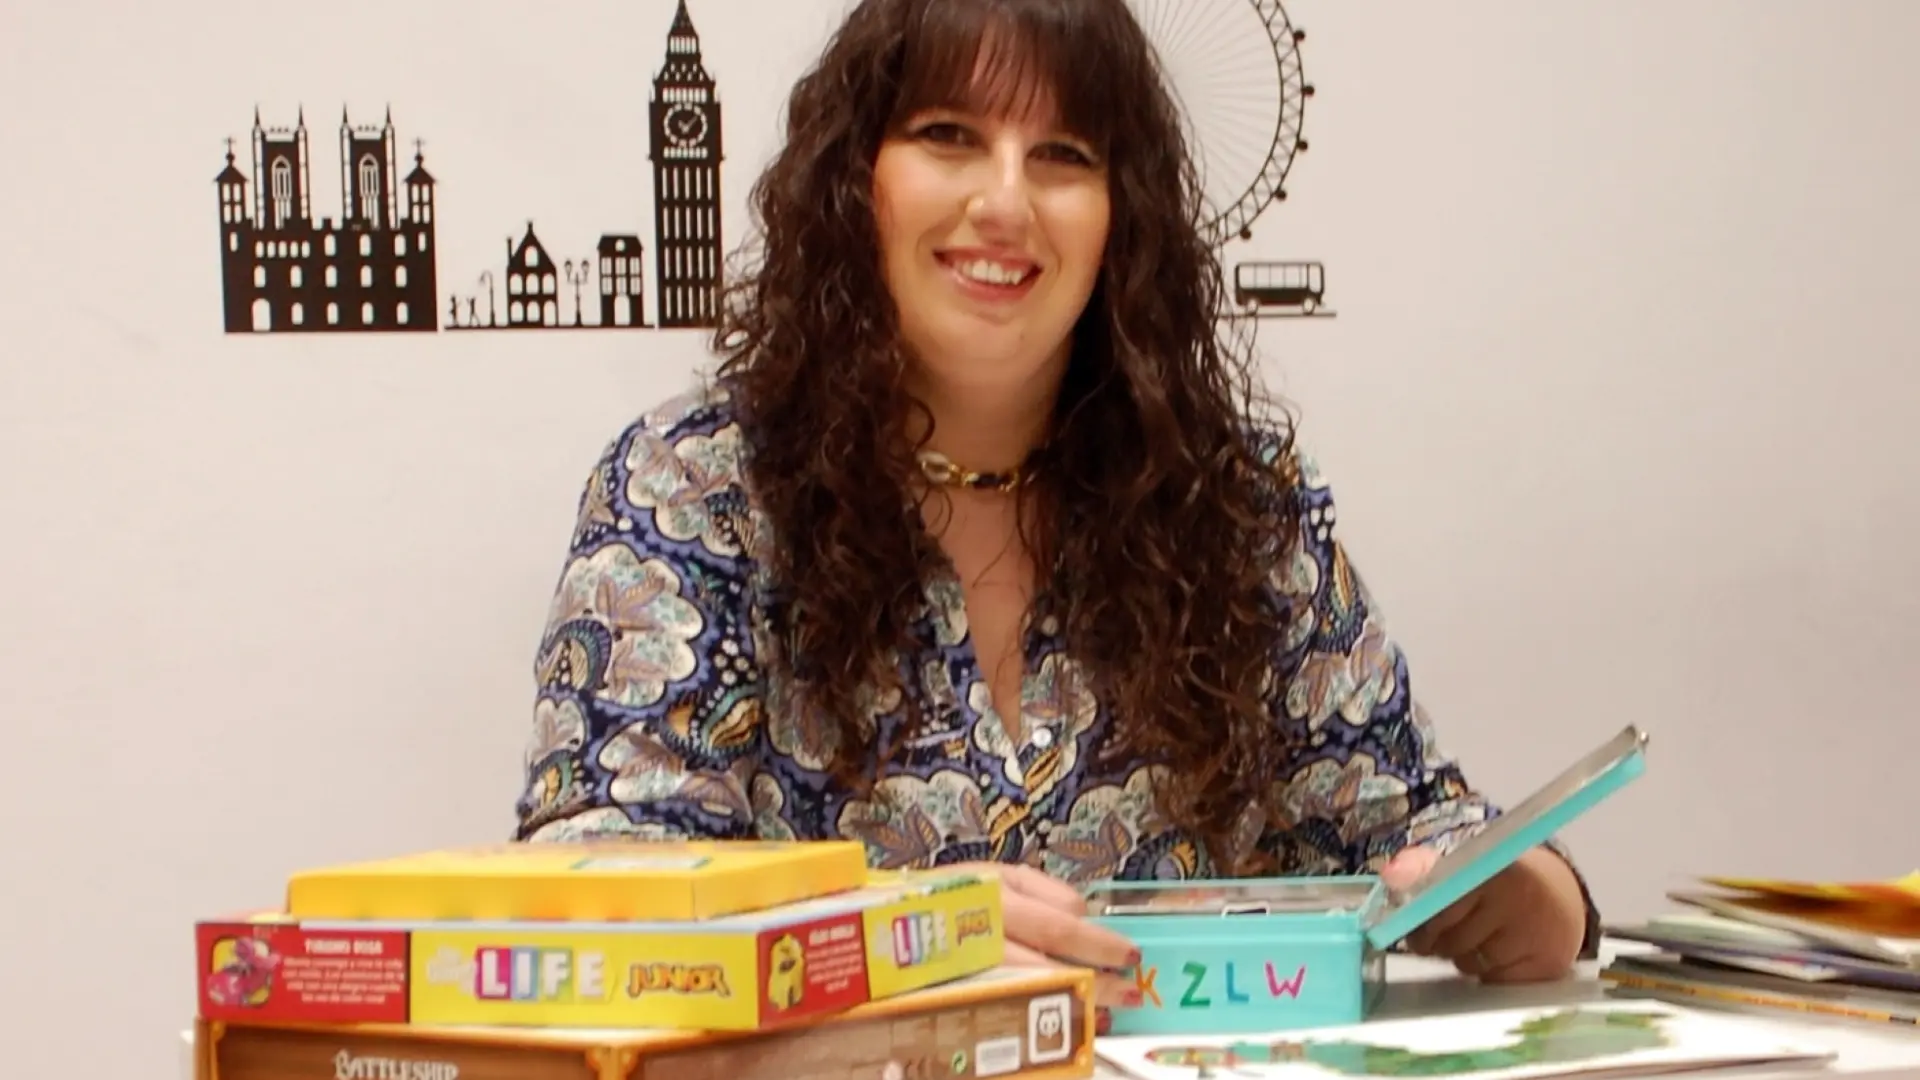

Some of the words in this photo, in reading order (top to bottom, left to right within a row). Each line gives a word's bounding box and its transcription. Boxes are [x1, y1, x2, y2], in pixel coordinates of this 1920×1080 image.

[893, 909, 948, 967] LIFE
[478, 947, 608, 999] LIFE
[626, 962, 731, 998] JUNIOR
[333, 1048, 459, 1080] BATTLESHIP
